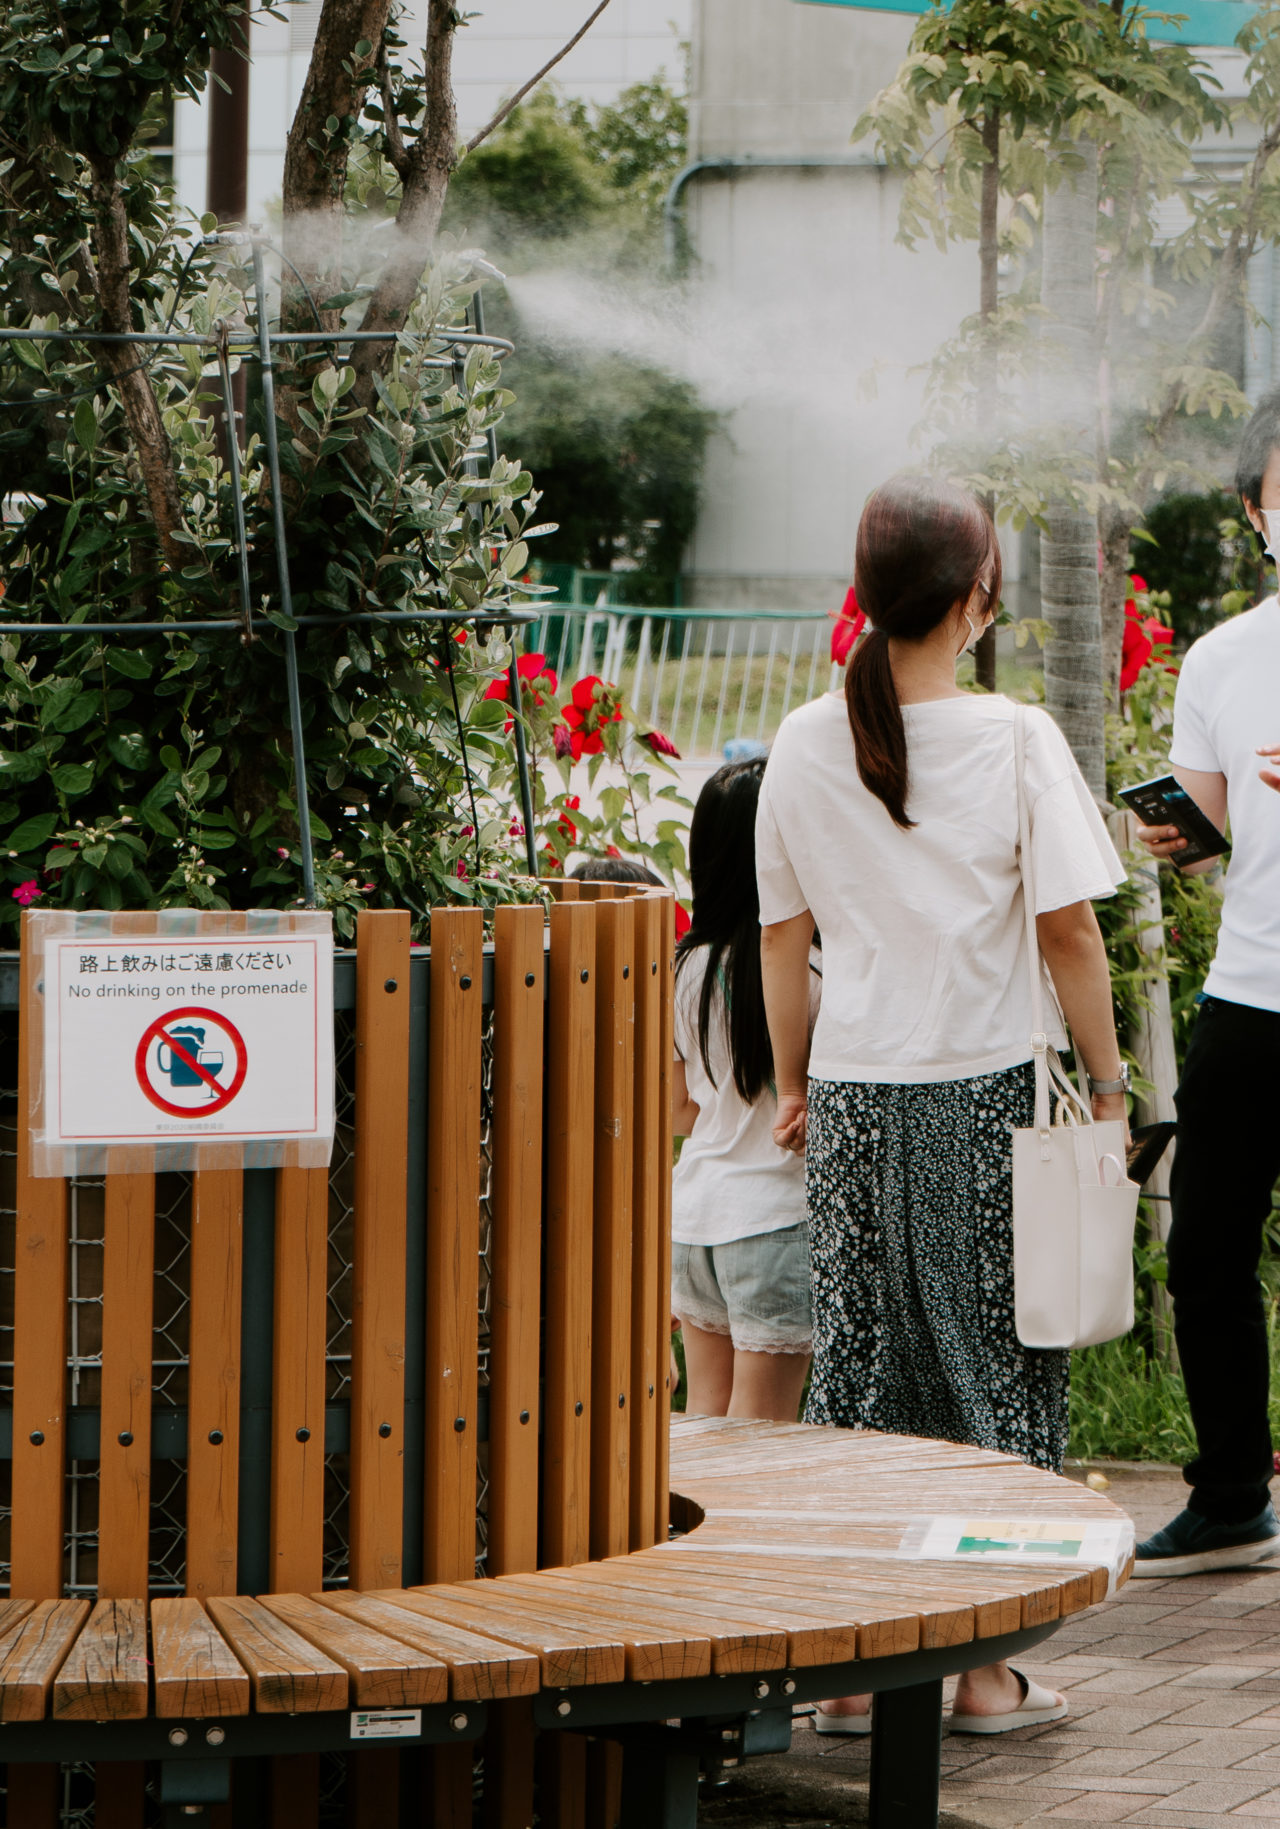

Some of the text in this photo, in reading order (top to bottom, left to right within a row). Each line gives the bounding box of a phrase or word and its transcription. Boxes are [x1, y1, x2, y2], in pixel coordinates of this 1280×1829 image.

[79, 952, 292, 973] 路上飲みはご遠慮ください
[69, 979, 308, 1000] No drinking on the promenade
